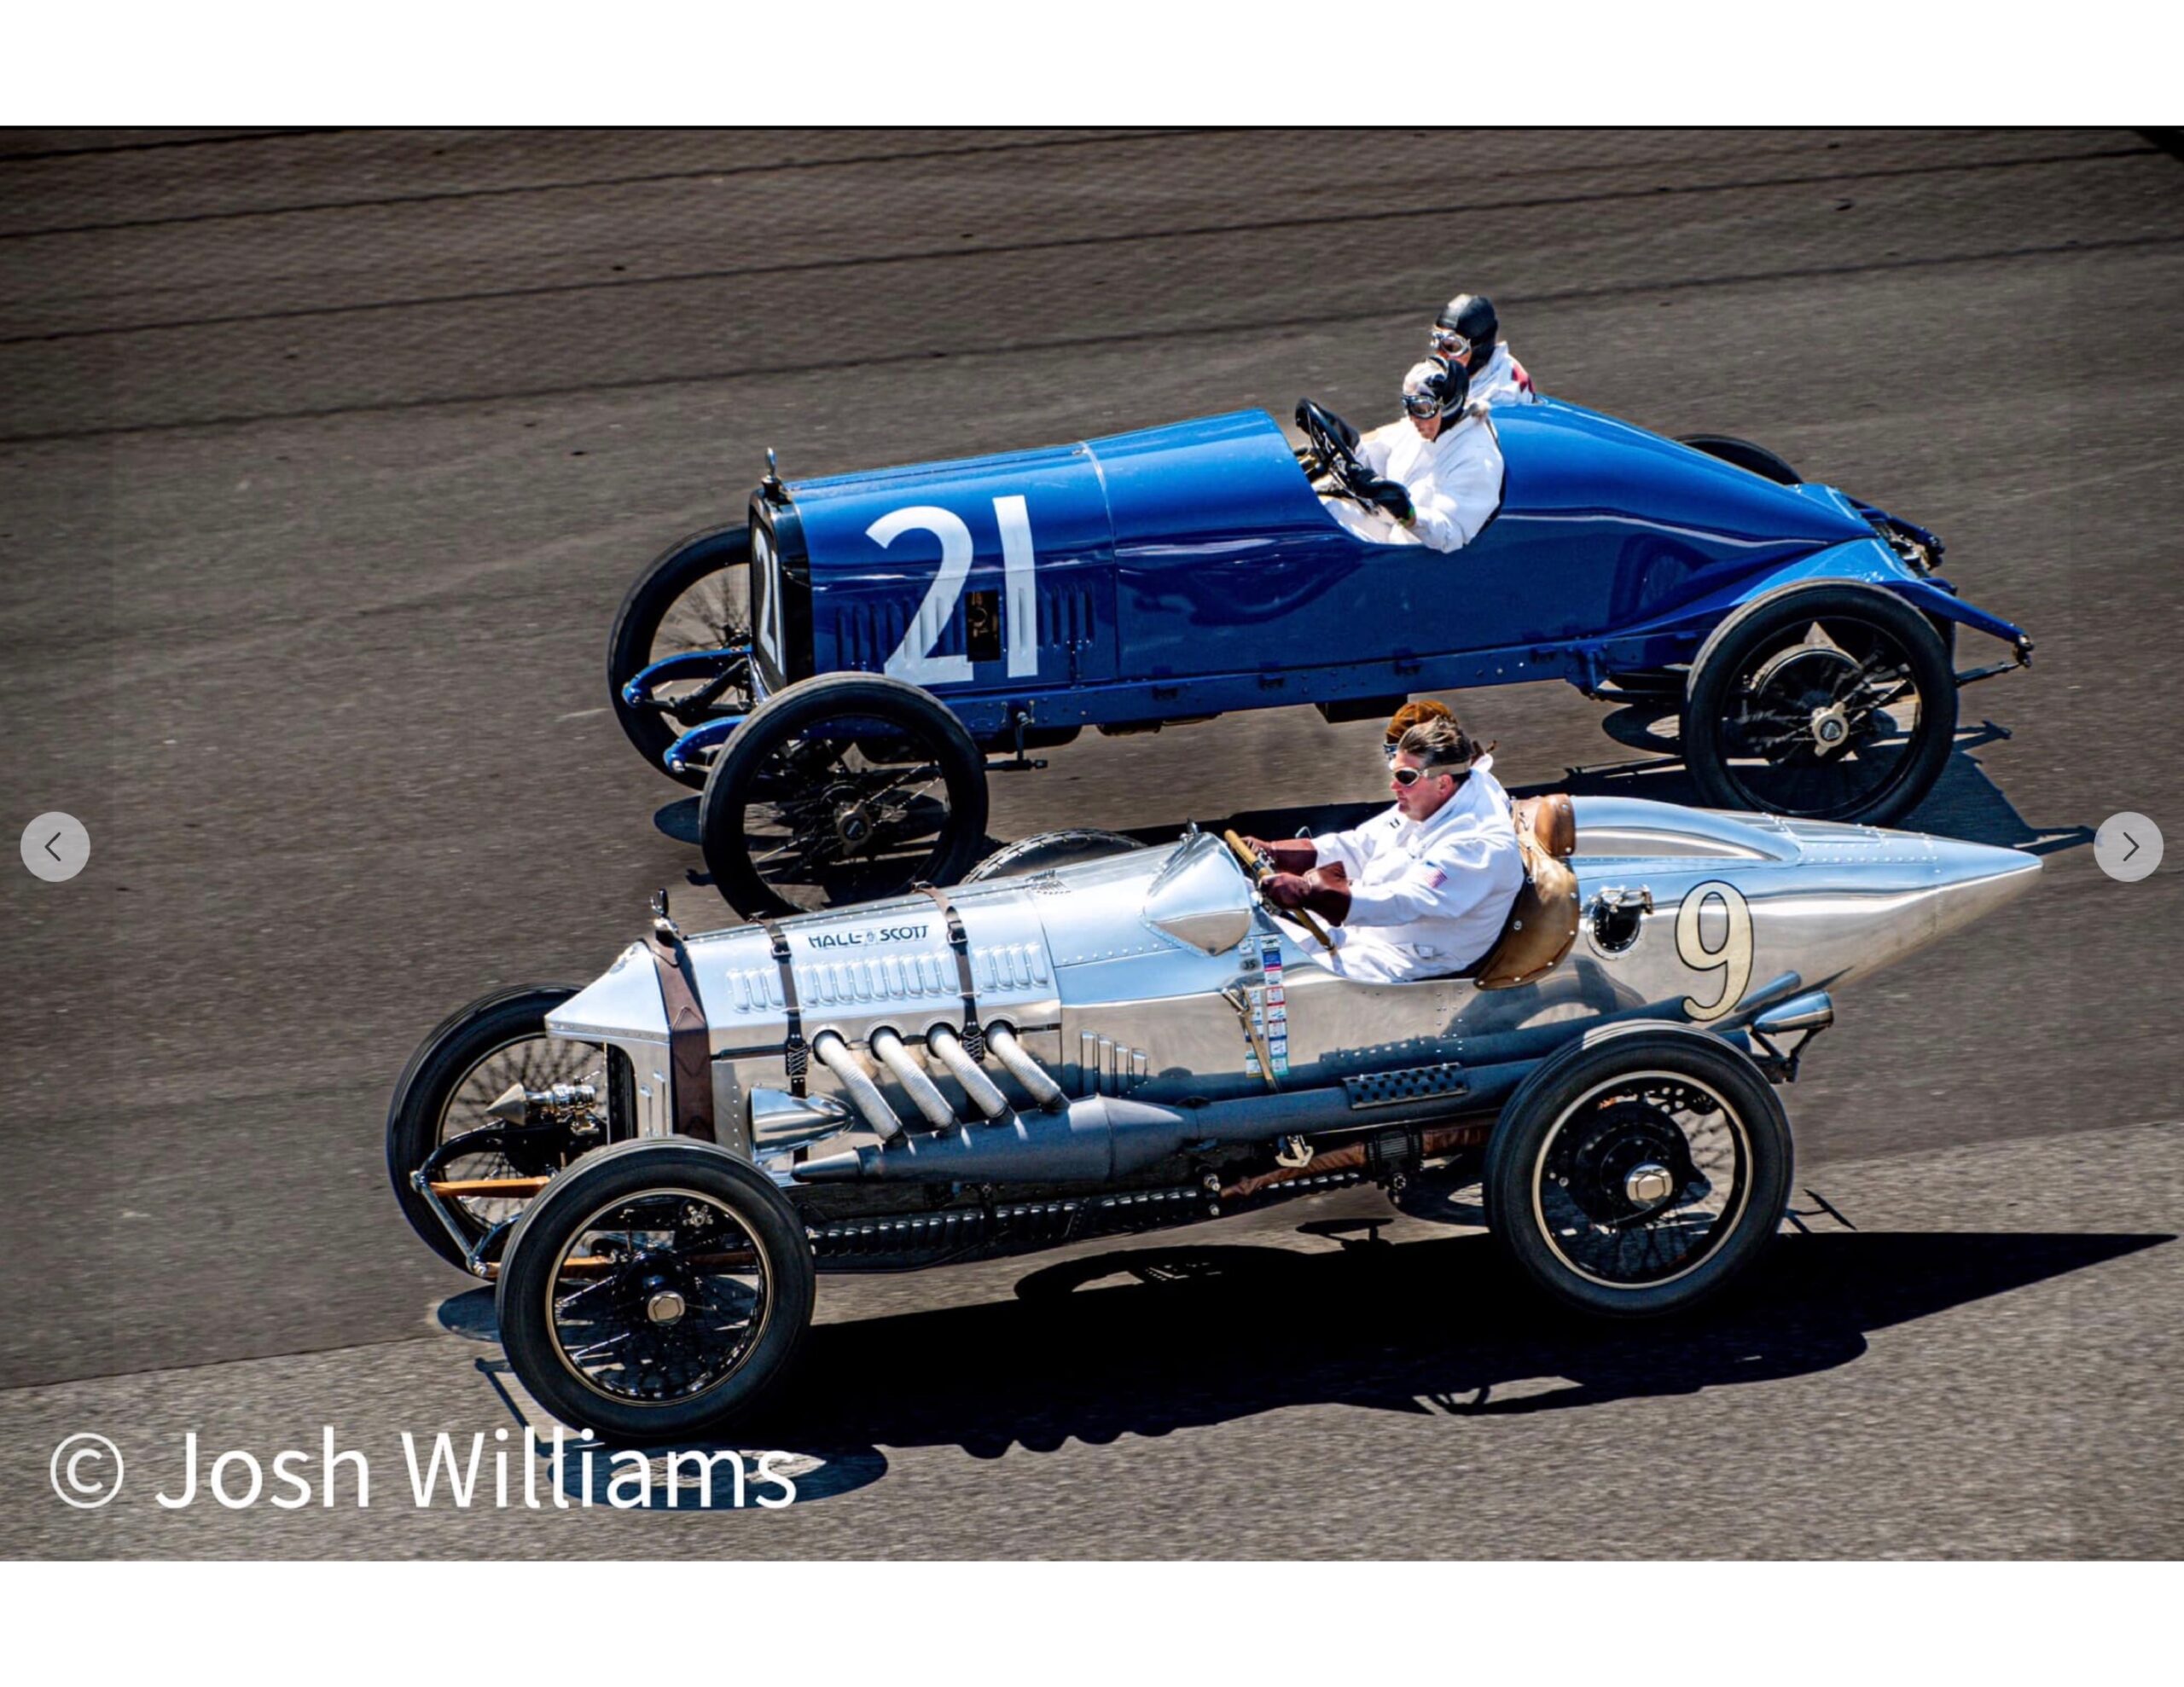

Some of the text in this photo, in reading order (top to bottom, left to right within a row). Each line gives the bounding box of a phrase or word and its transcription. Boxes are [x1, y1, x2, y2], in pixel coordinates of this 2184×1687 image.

[865, 495, 1038, 685] 21
[880, 925, 929, 942] SCOTT
[1674, 879, 1754, 1022] 9
